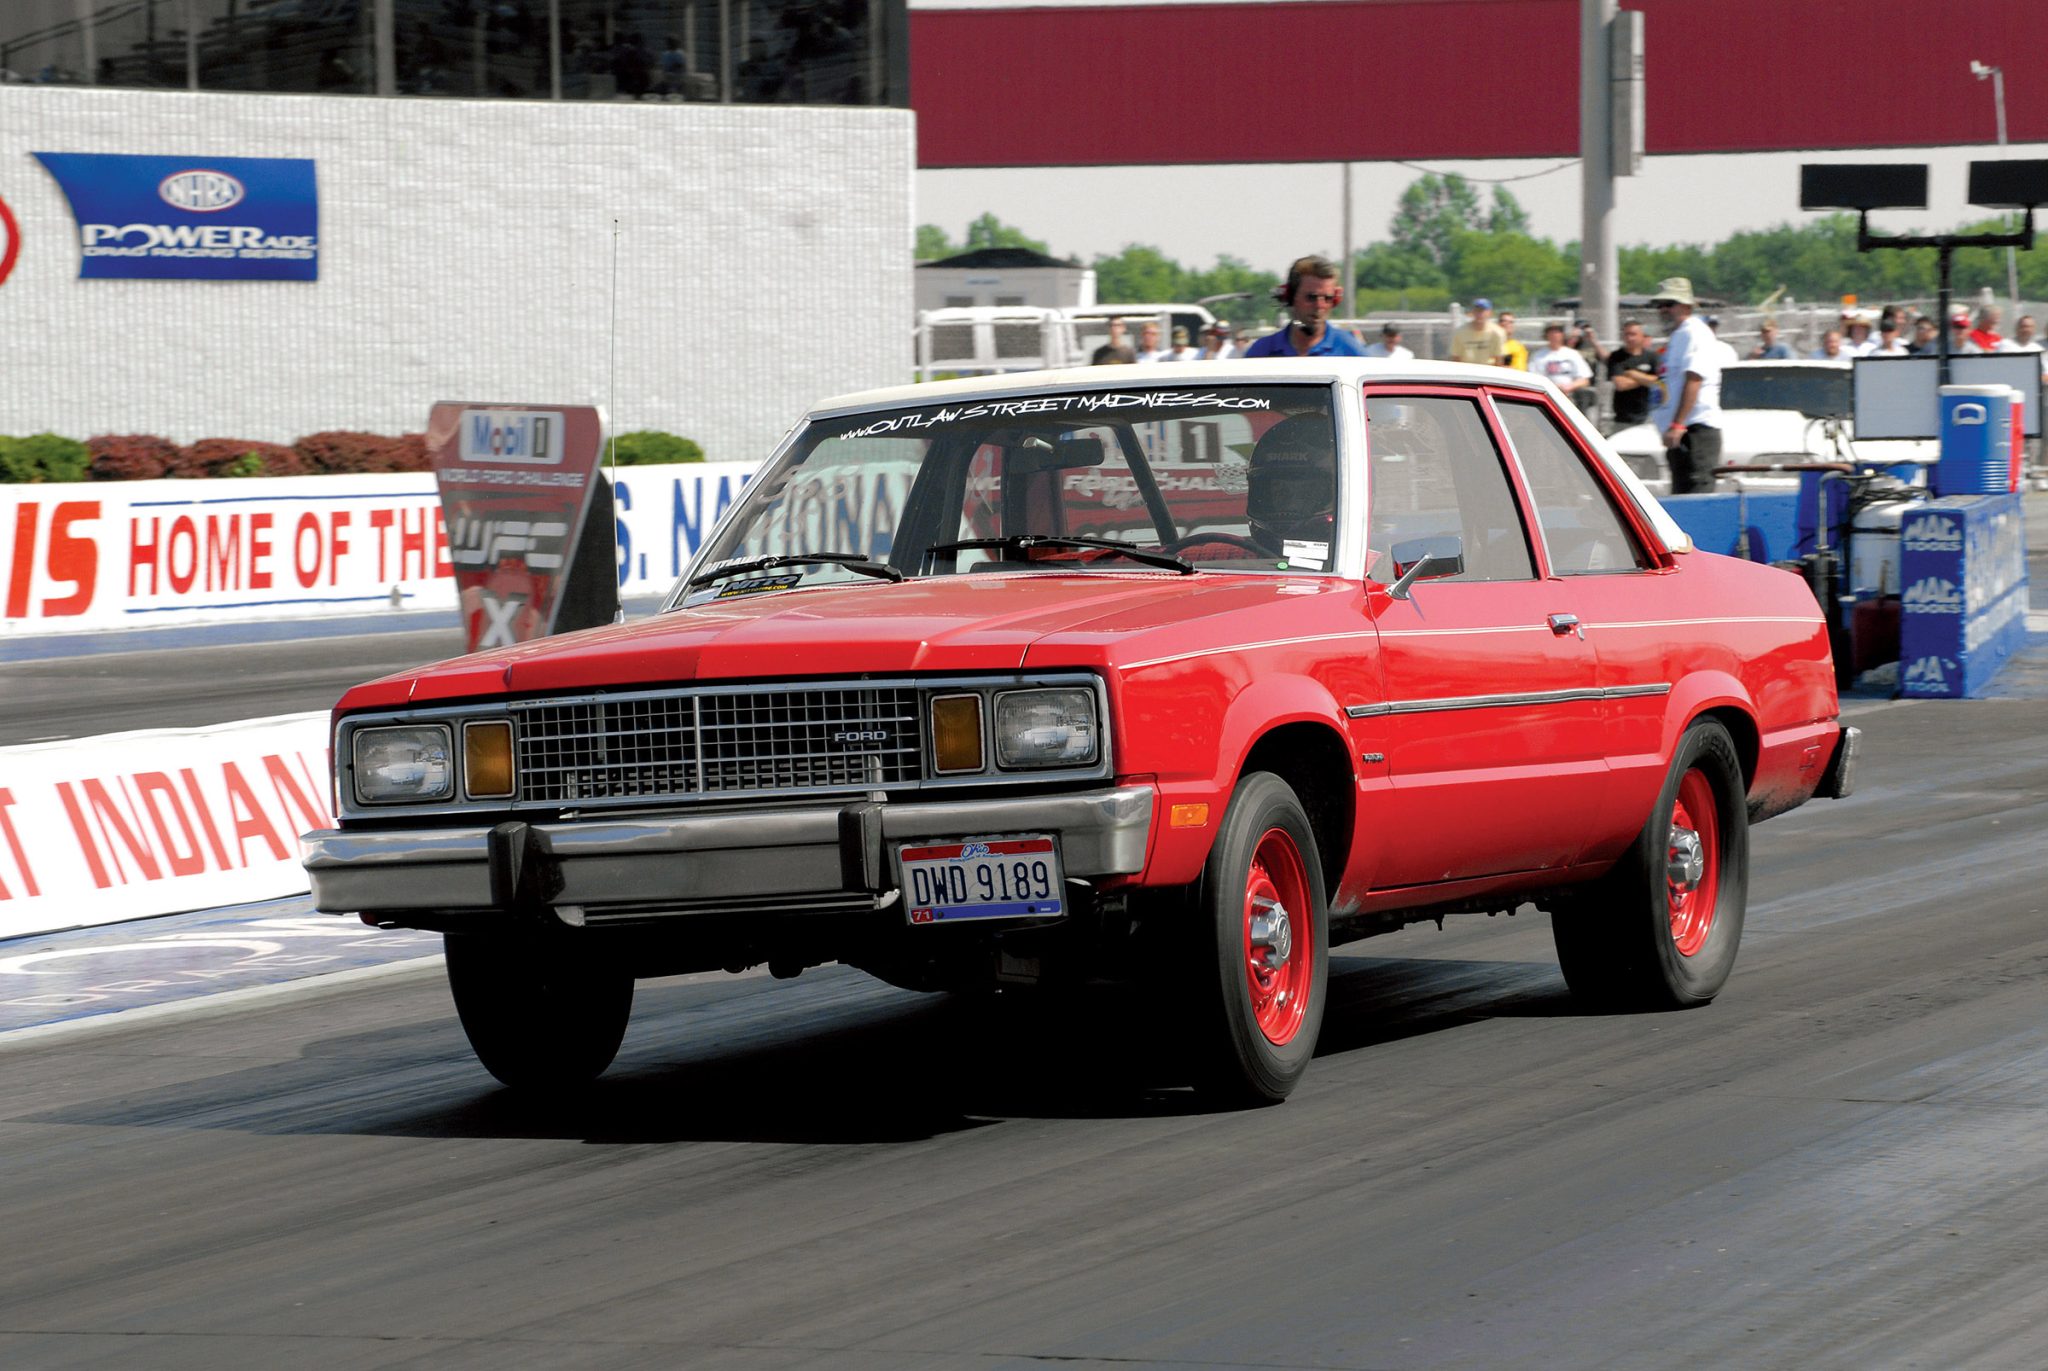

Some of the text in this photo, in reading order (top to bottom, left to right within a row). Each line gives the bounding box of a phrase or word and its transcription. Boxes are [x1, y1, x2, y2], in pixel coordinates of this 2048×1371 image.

[164, 173, 239, 208] NHRA
[151, 247, 235, 259] RACING
[238, 249, 313, 259] SERIES
[472, 415, 529, 456] Mobil
[127, 513, 272, 596] HOME
[295, 511, 350, 588] OF
[371, 505, 456, 582] THE
[1904, 541, 1962, 551] TOOLS
[1903, 603, 1961, 613] TOOLS
[834, 730, 887, 742] FORD
[54, 748, 337, 890] INDIAN
[961, 843, 990, 858] Ohio
[912, 861, 1050, 906] DWD 9189
